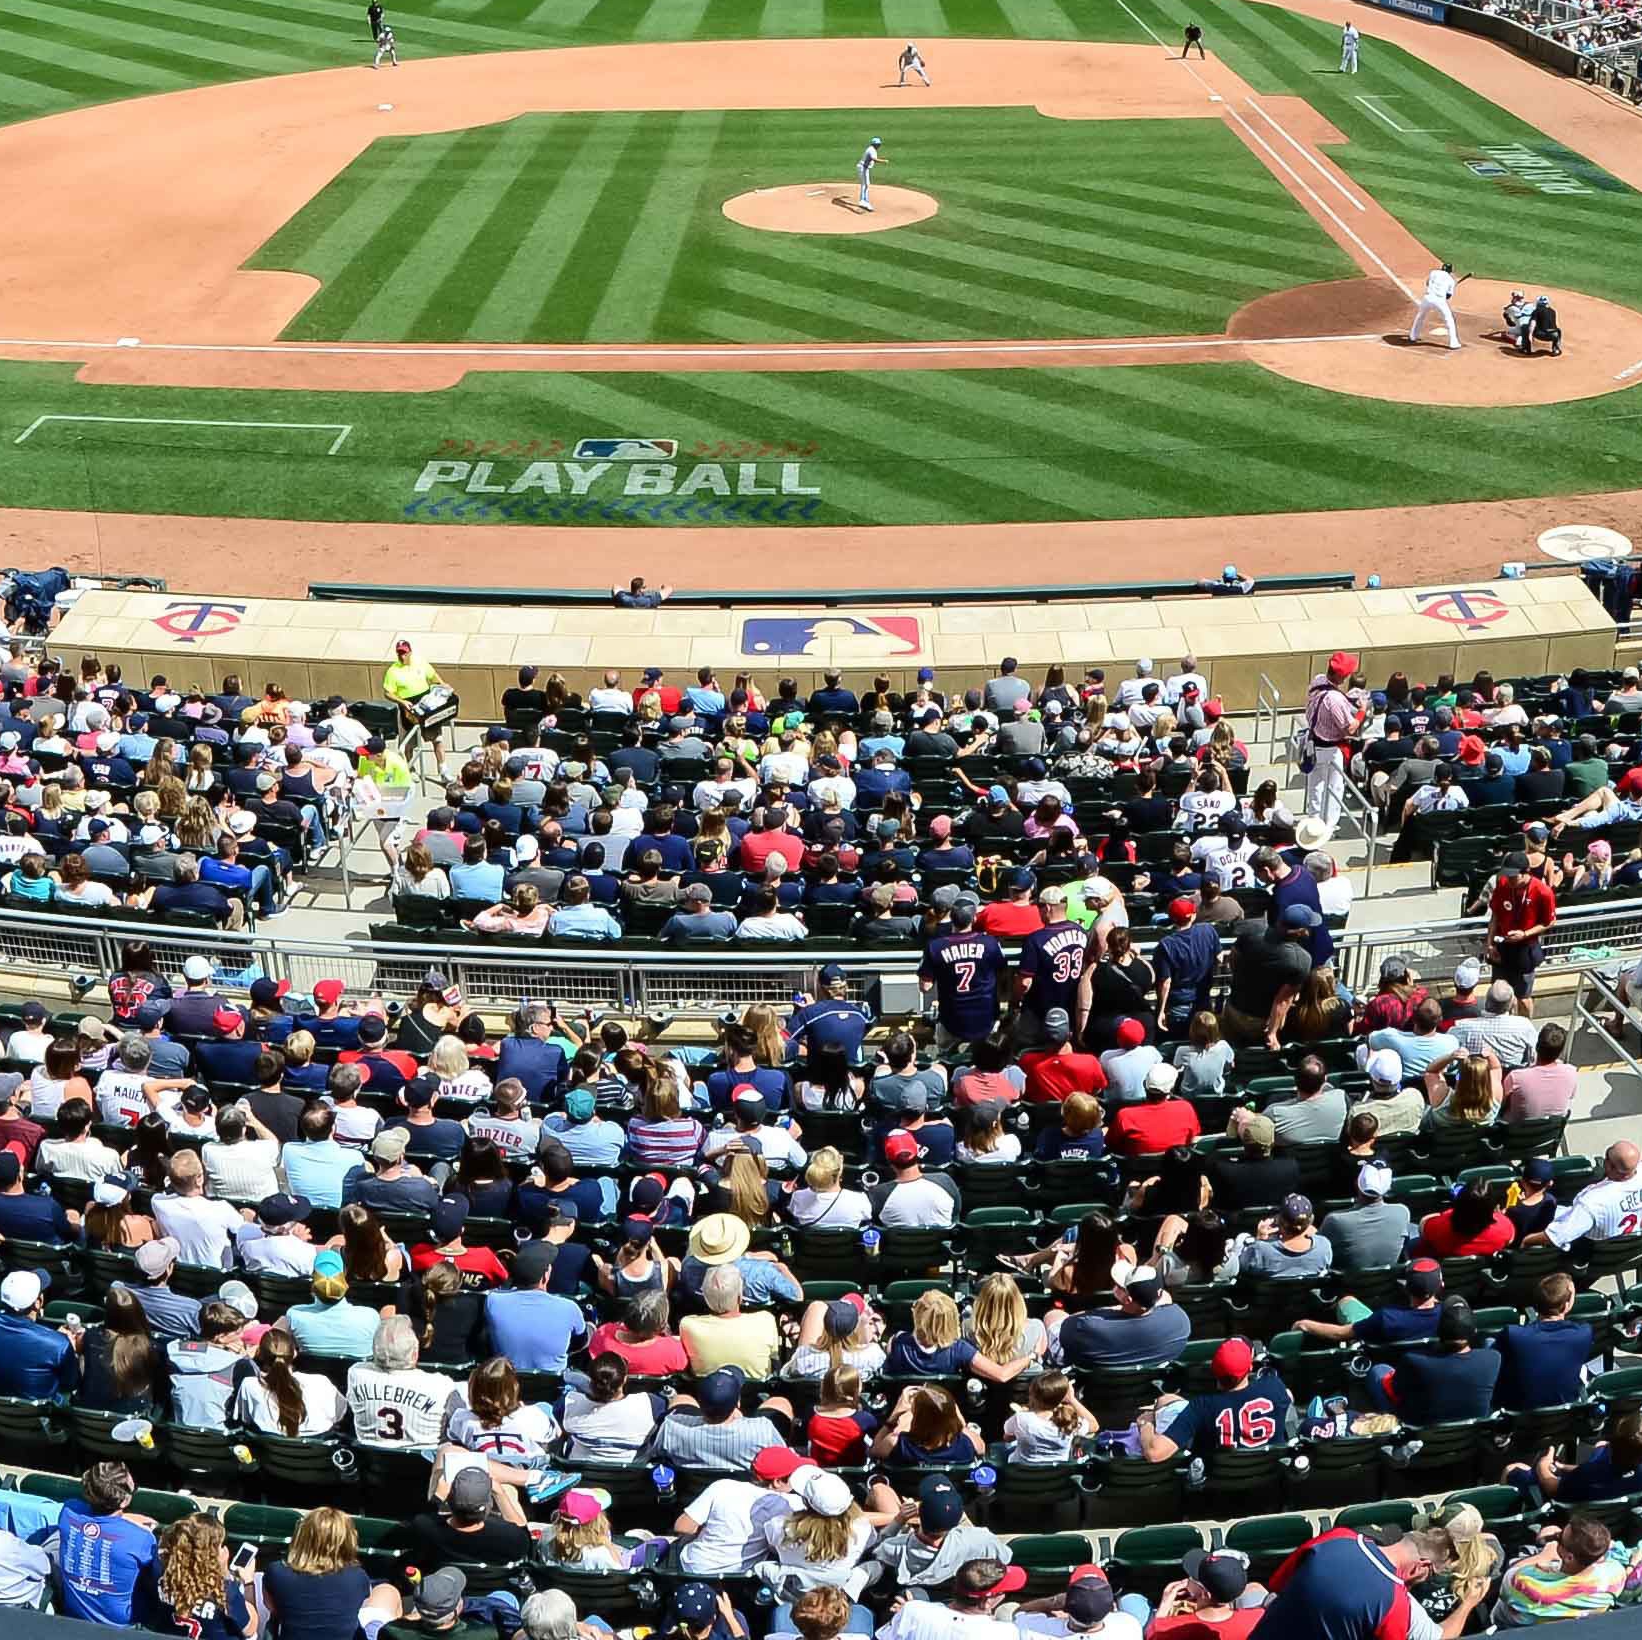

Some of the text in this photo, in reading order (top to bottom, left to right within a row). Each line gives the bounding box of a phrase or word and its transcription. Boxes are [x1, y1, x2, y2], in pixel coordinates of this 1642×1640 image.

[413, 460, 822, 497] PLAY BALL
[1192, 812, 1220, 830] 22
[1230, 866, 1246, 888] 2
[940, 943, 985, 963] MAUER
[1052, 948, 1084, 983] 33
[954, 962, 976, 992] 7
[120, 1107, 141, 1127] 7
[353, 1382, 437, 1414] KILLEBREW
[377, 1406, 405, 1441] 3
[1215, 1399, 1276, 1450] 16
